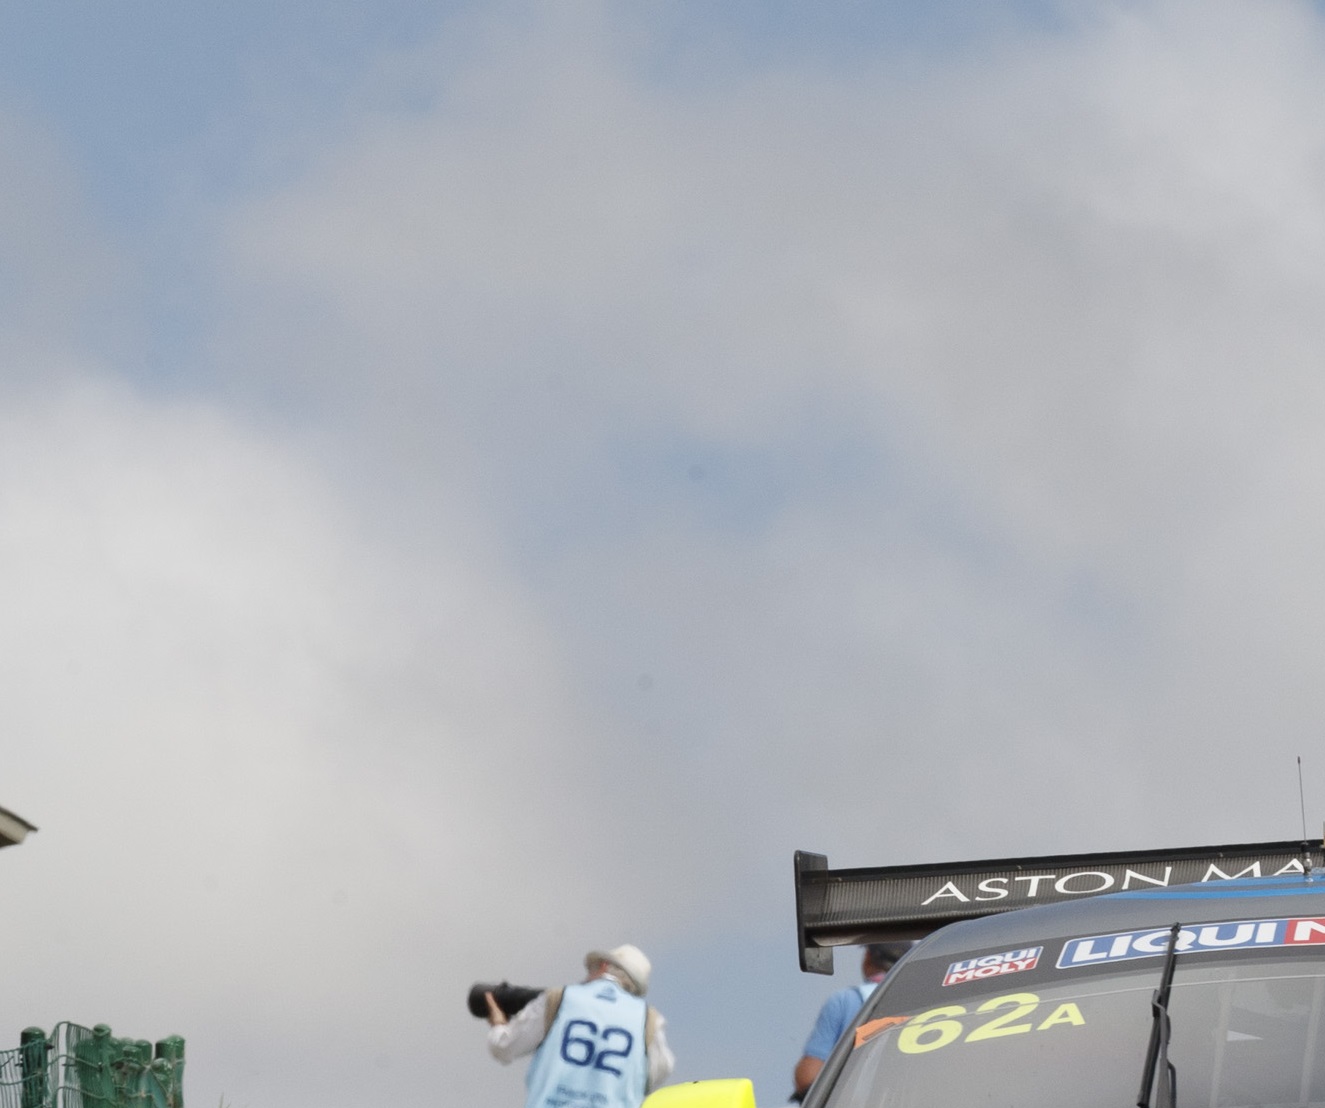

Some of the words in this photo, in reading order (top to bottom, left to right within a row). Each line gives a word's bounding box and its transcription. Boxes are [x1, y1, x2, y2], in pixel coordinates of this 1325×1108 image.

[921, 866, 1172, 905] ASTON
[951, 949, 1038, 973] LIQUI
[1072, 922, 1278, 963] LIQUI
[947, 959, 1036, 984] MOLY
[560, 1020, 634, 1077] 62
